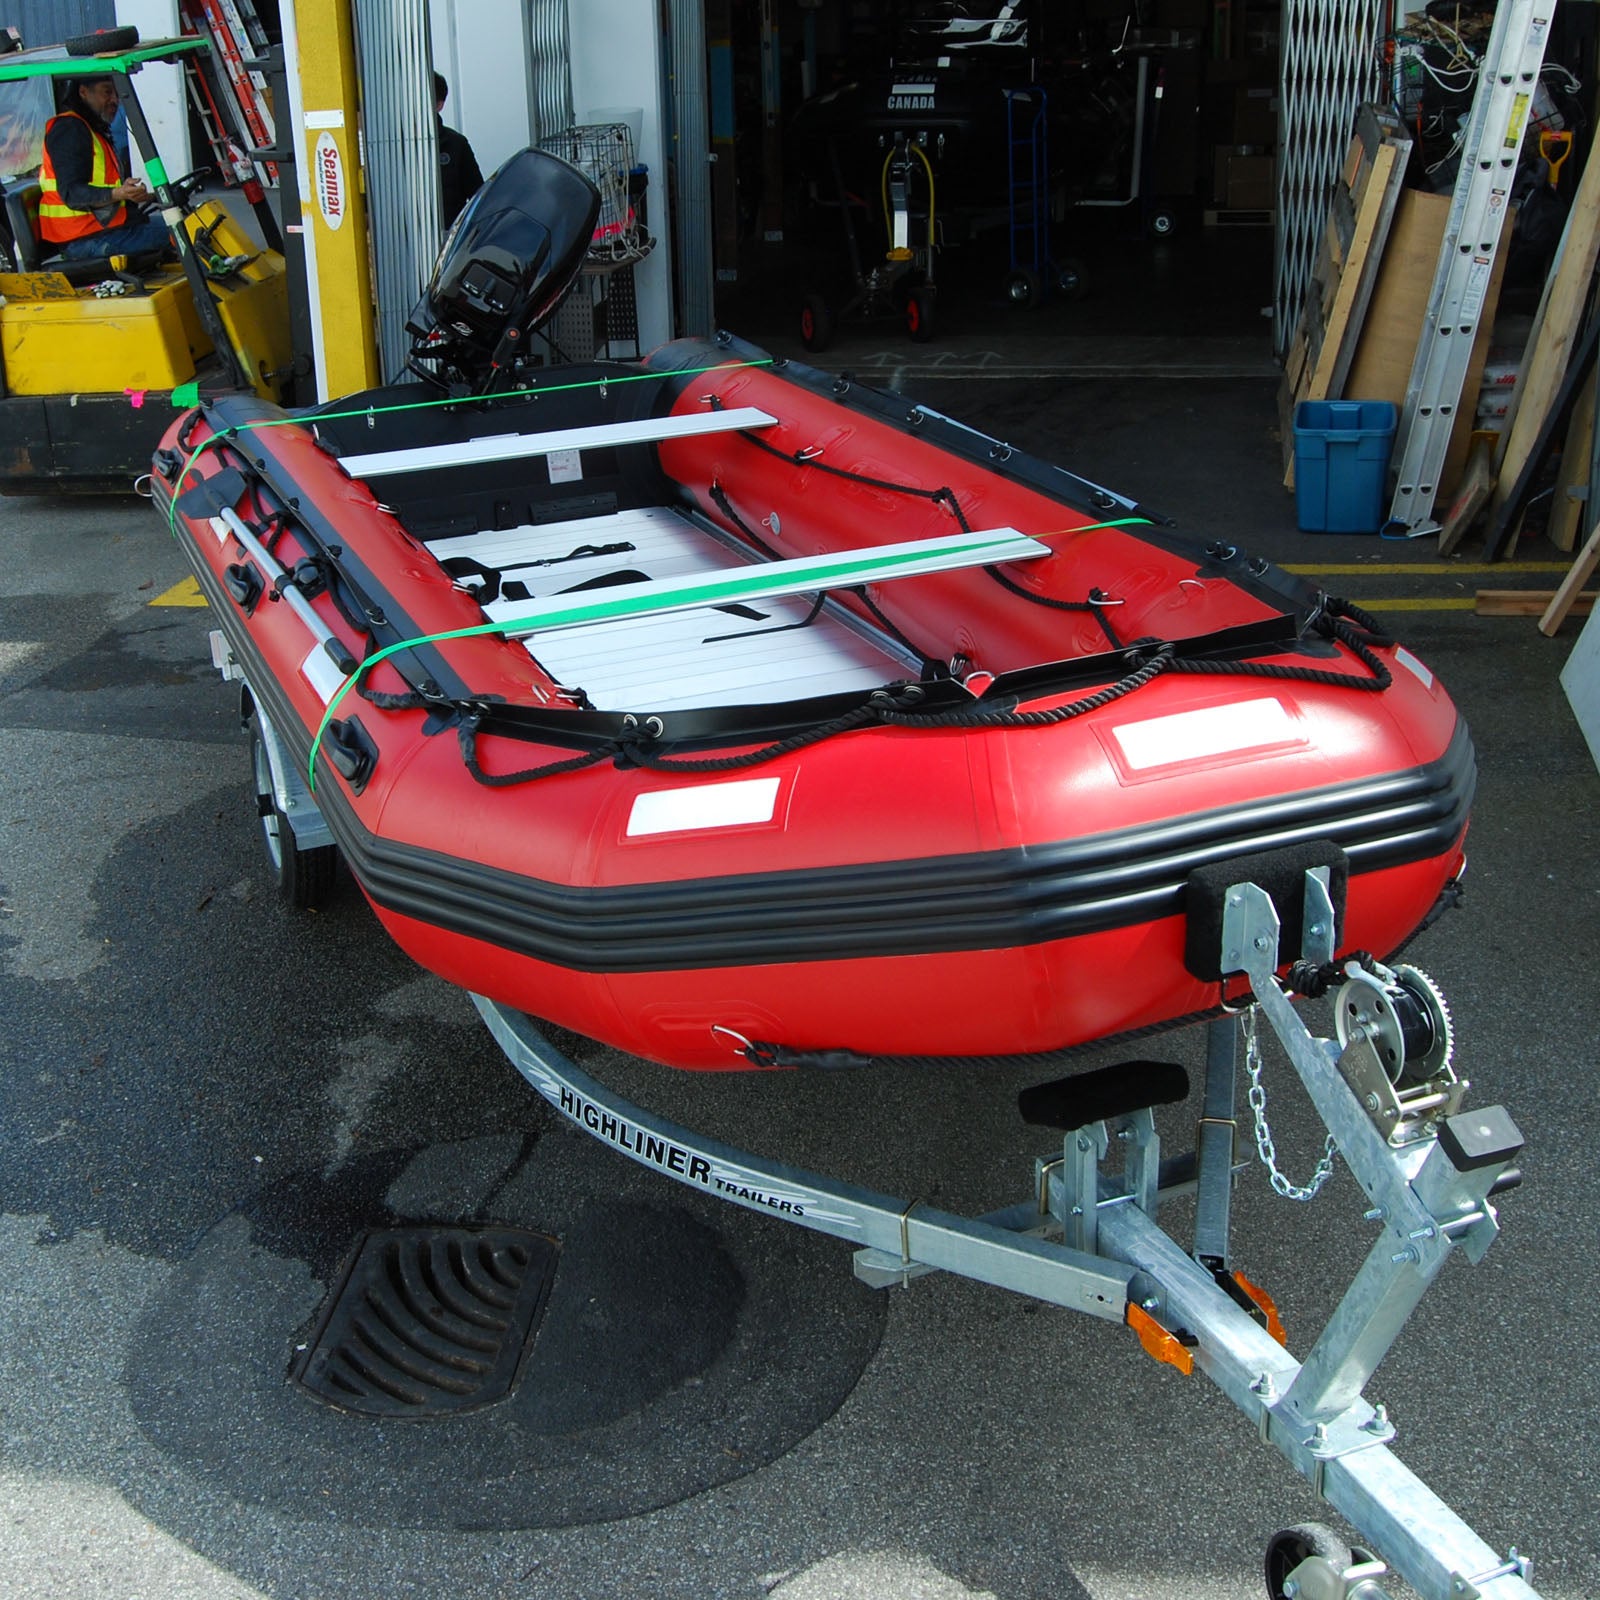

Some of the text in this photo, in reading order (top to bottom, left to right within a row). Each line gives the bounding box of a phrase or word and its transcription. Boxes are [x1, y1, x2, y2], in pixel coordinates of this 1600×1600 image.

[887, 96, 935, 109] CANADA
[323, 147, 341, 217] Seamax
[559, 1086, 806, 1217] HIGHLINER TRAILERS
